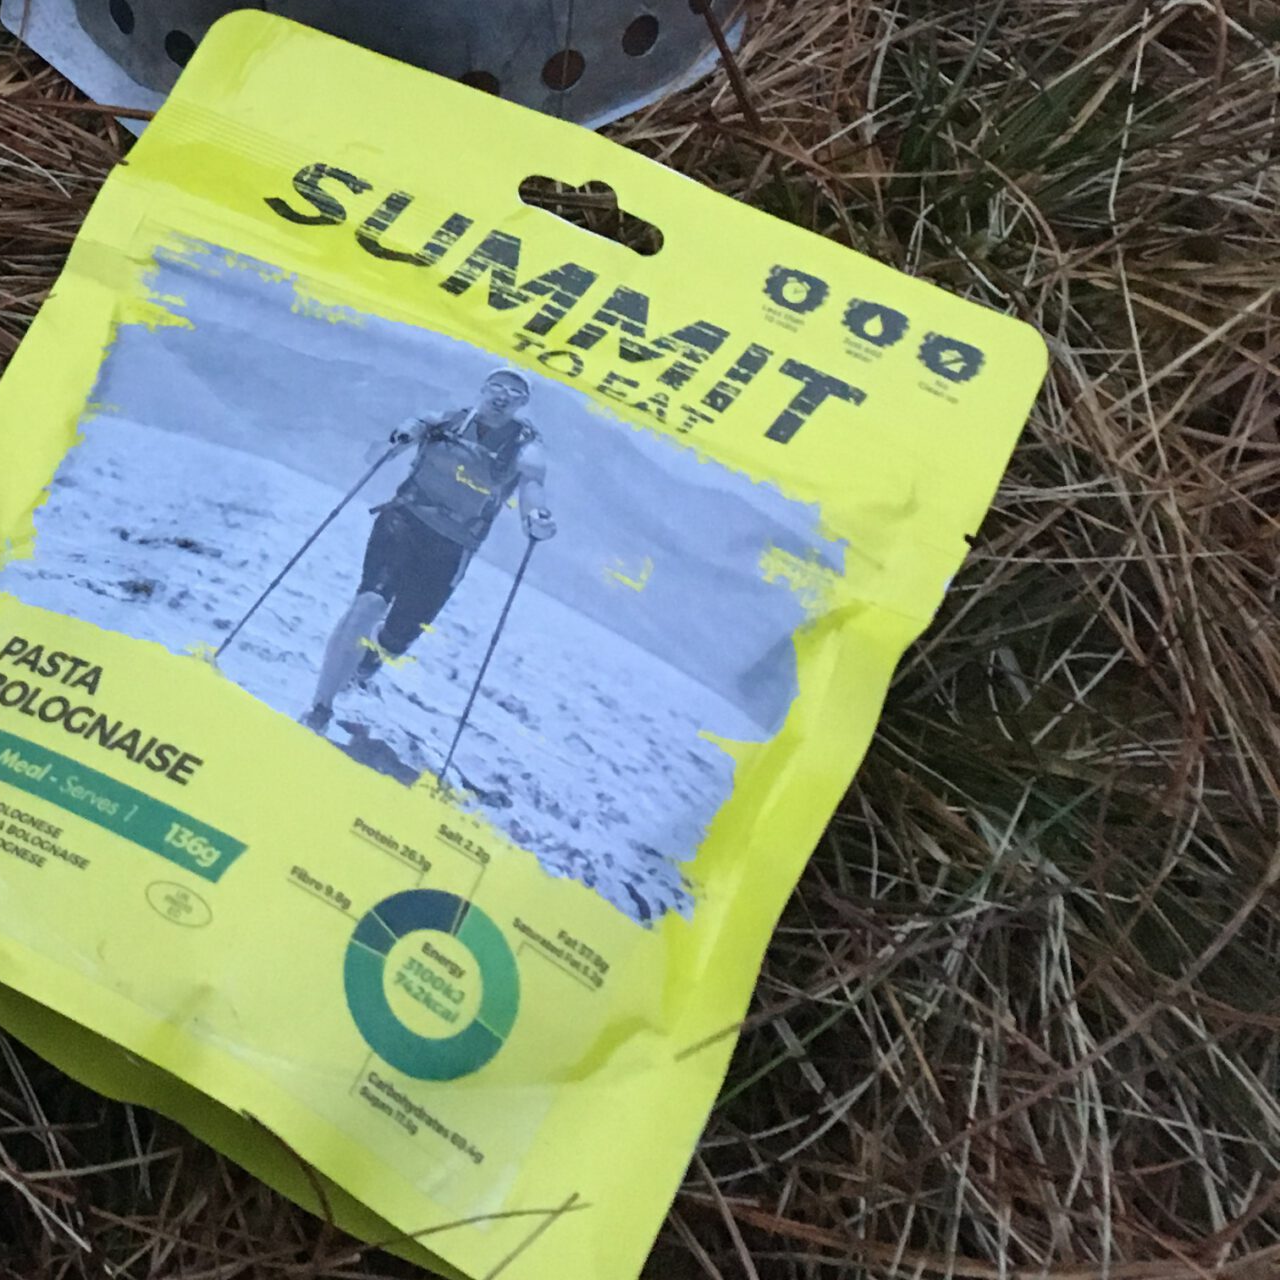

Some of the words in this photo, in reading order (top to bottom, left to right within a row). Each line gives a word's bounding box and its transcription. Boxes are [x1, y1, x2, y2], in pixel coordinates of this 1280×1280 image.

[263, 162, 867, 444] SUMMIT
[512, 332, 584, 377] TO
[596, 371, 715, 433] EAT
[60, 775, 120, 816] Serves
[163, 822, 222, 867] 136g
[353, 817, 399, 850] Protein
[437, 824, 463, 845] Salt
[6, 824, 91, 870] BOLOGNAISE
[290, 865, 323, 892] Fibre
[422, 941, 467, 979] Energy
[557, 929, 578, 950] Fat
[368, 1071, 450, 1139] Carbohydrates
